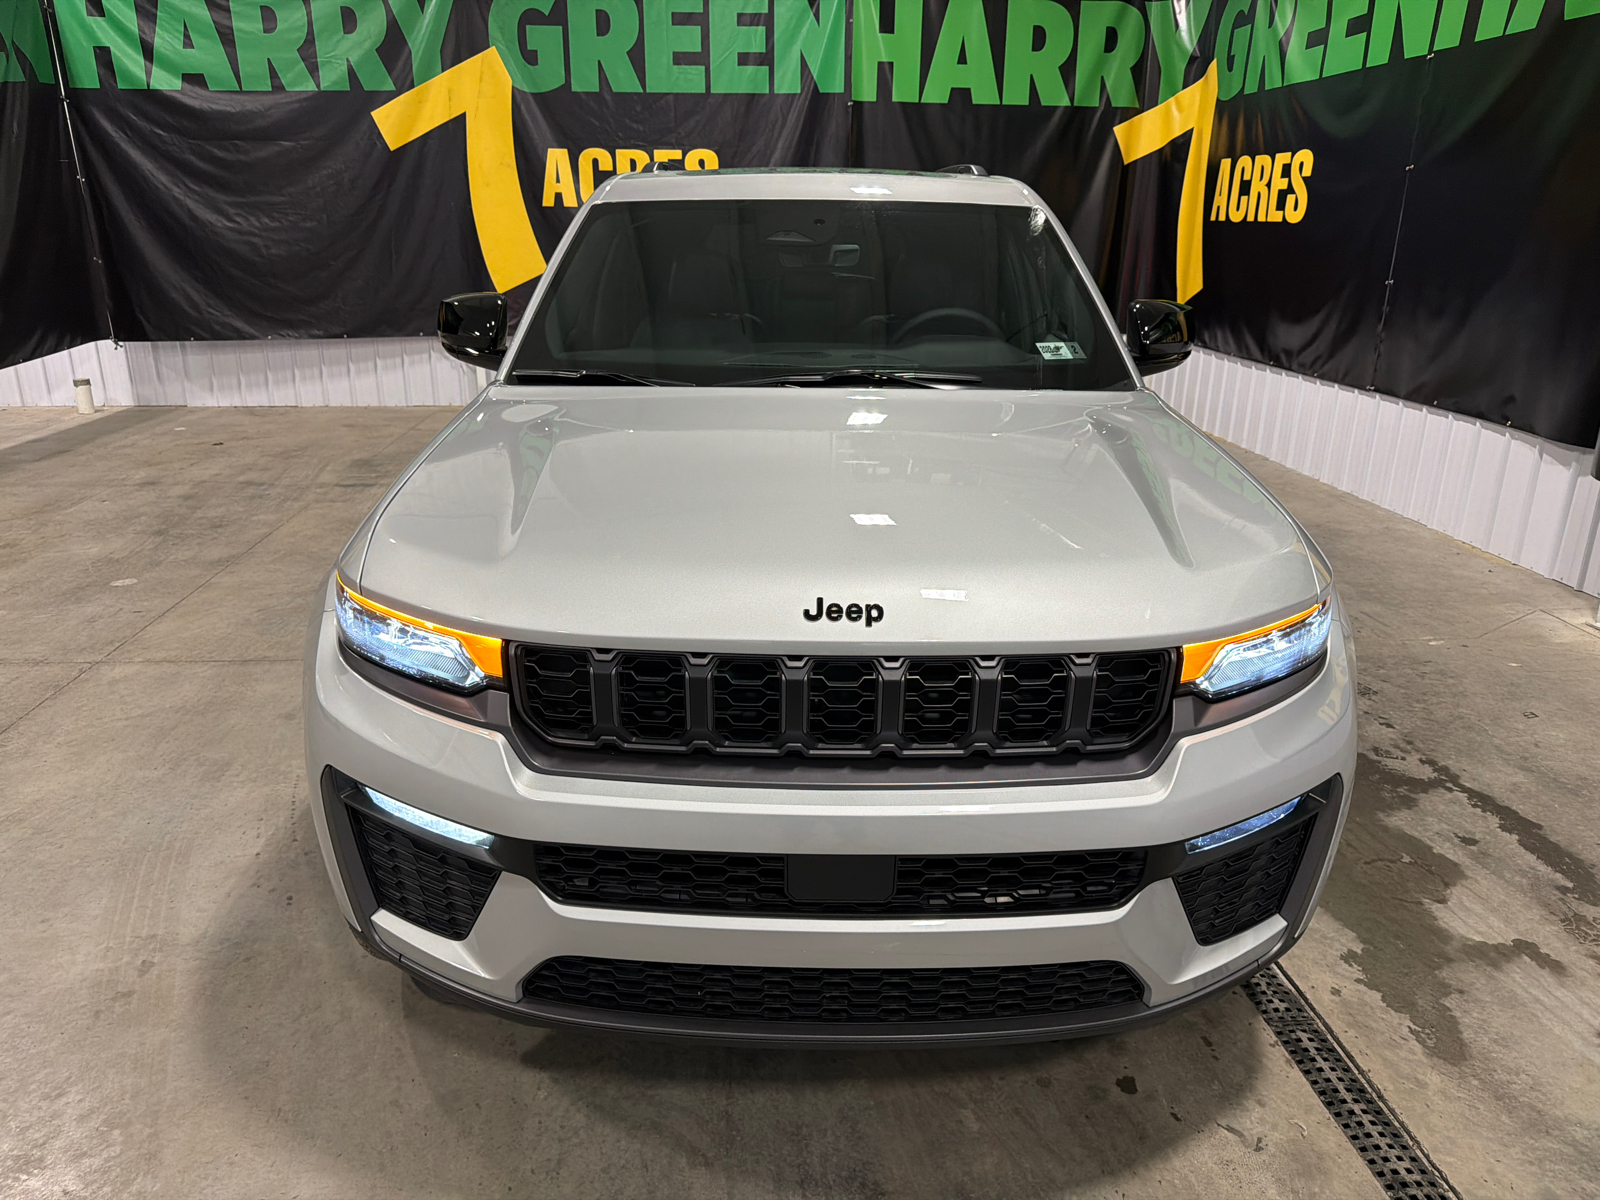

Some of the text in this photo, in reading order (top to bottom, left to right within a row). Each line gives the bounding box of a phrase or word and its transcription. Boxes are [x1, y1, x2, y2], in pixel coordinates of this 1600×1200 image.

[53, 0, 846, 94] HARRY GREEN
[852, 0, 1213, 108] HARRY
[371, 46, 547, 294] 7
[1113, 58, 1218, 304] 7
[1210, 149, 1314, 223] ACRES
[803, 597, 884, 628] Jeep
